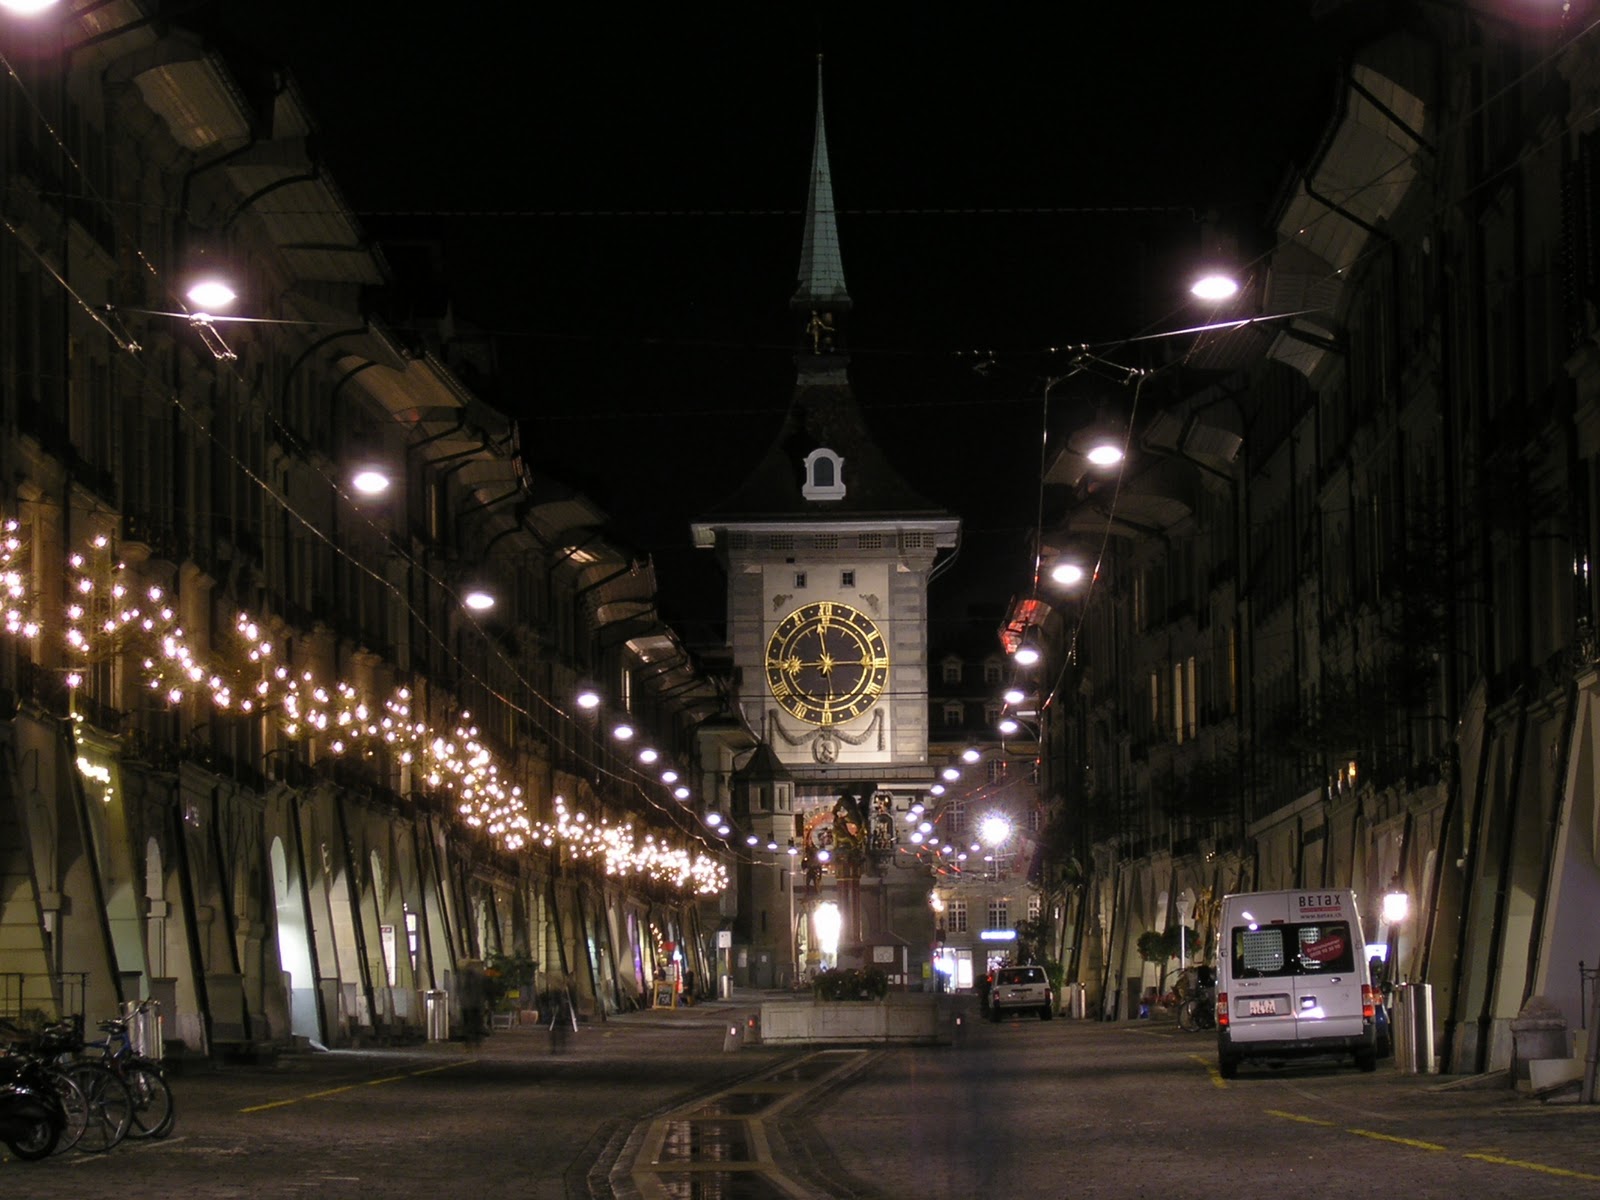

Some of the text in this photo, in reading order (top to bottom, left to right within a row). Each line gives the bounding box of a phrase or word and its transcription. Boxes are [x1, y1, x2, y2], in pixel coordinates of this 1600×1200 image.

[818, 603, 832, 616] XII
[792, 612, 805, 626] XI
[774, 632, 786, 644] X
[867, 630, 879, 641] II
[874, 657, 887, 668] III
[773, 681, 789, 700] VIII
[792, 702, 808, 718] VII
[849, 705, 860, 717] V
[822, 712, 832, 724] VI
